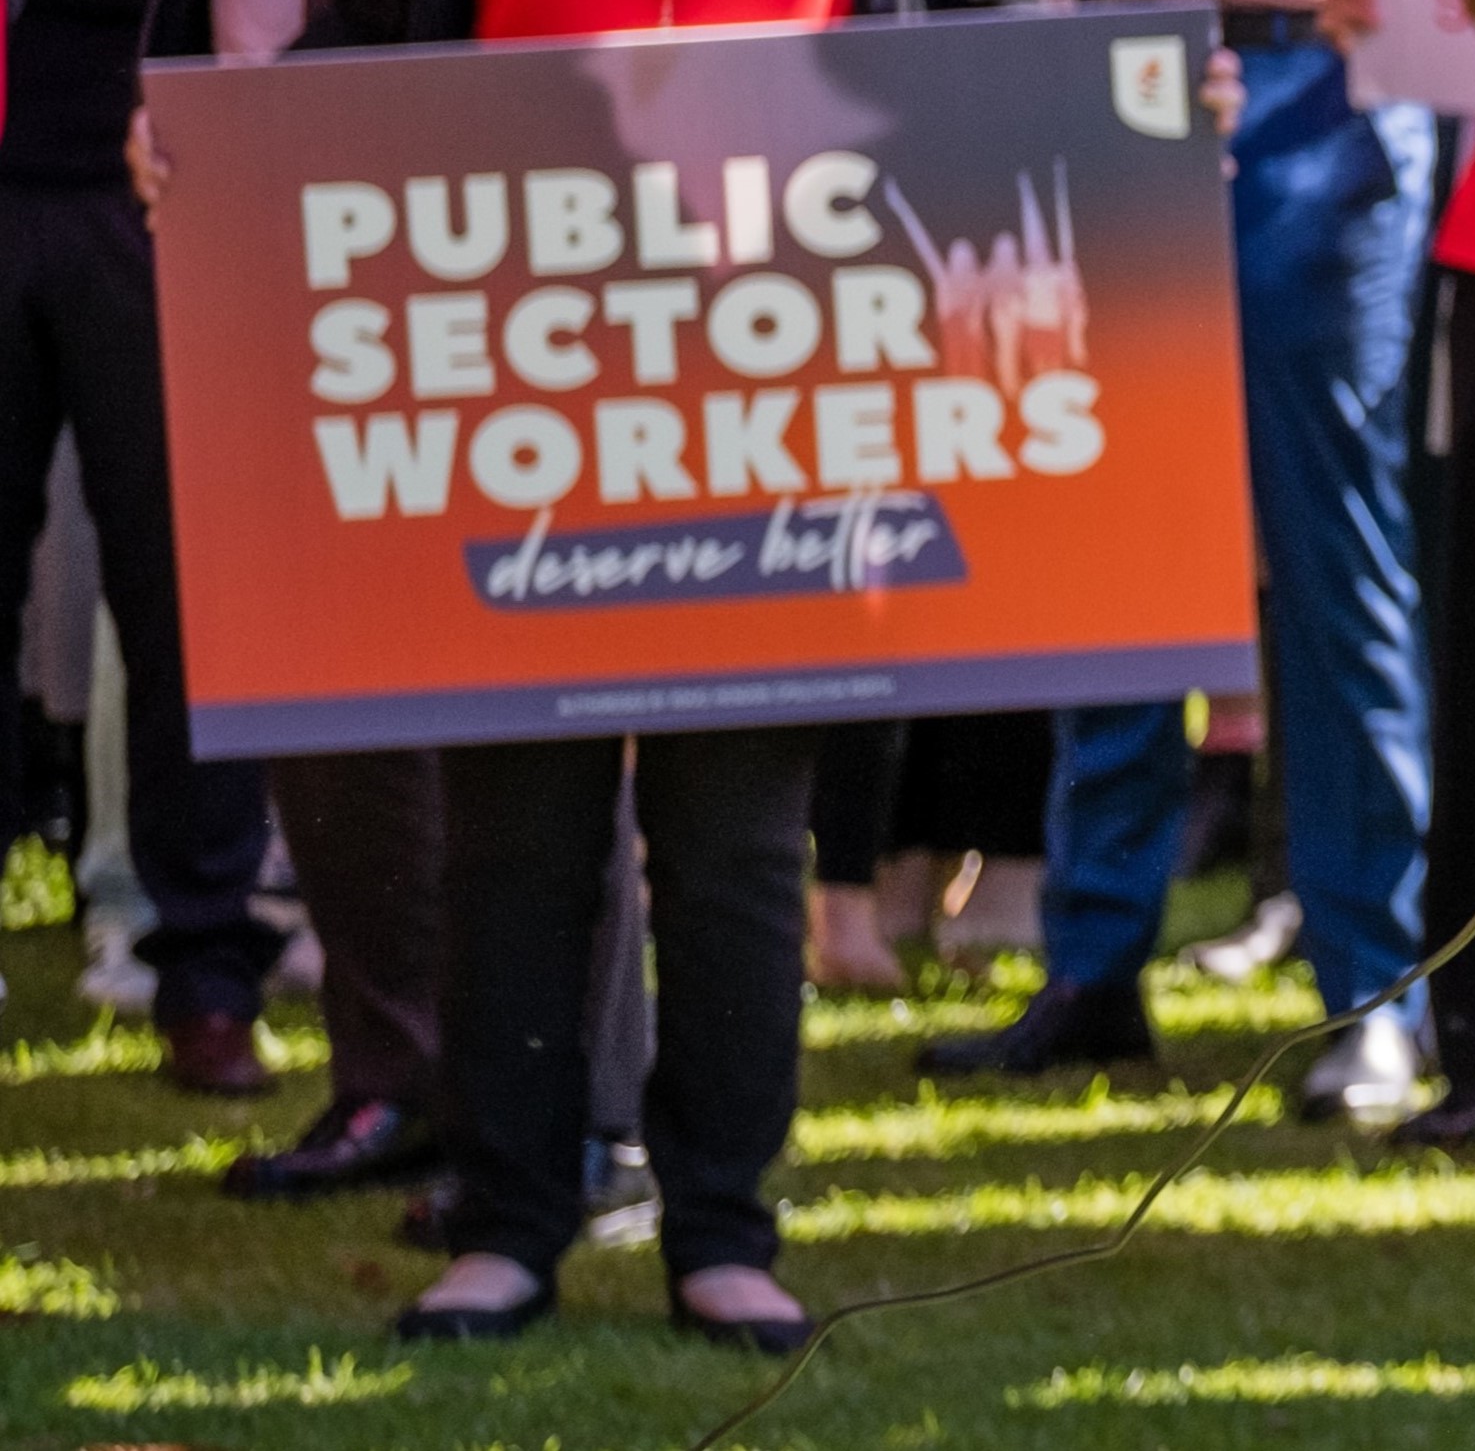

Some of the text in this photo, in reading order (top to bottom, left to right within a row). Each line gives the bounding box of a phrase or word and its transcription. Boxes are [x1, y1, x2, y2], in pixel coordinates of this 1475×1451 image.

[301, 151, 881, 288] PUBLIC
[309, 266, 936, 404] SECTOR
[313, 370, 1105, 521] WORKERS
[488, 482, 939, 602] deserve better
